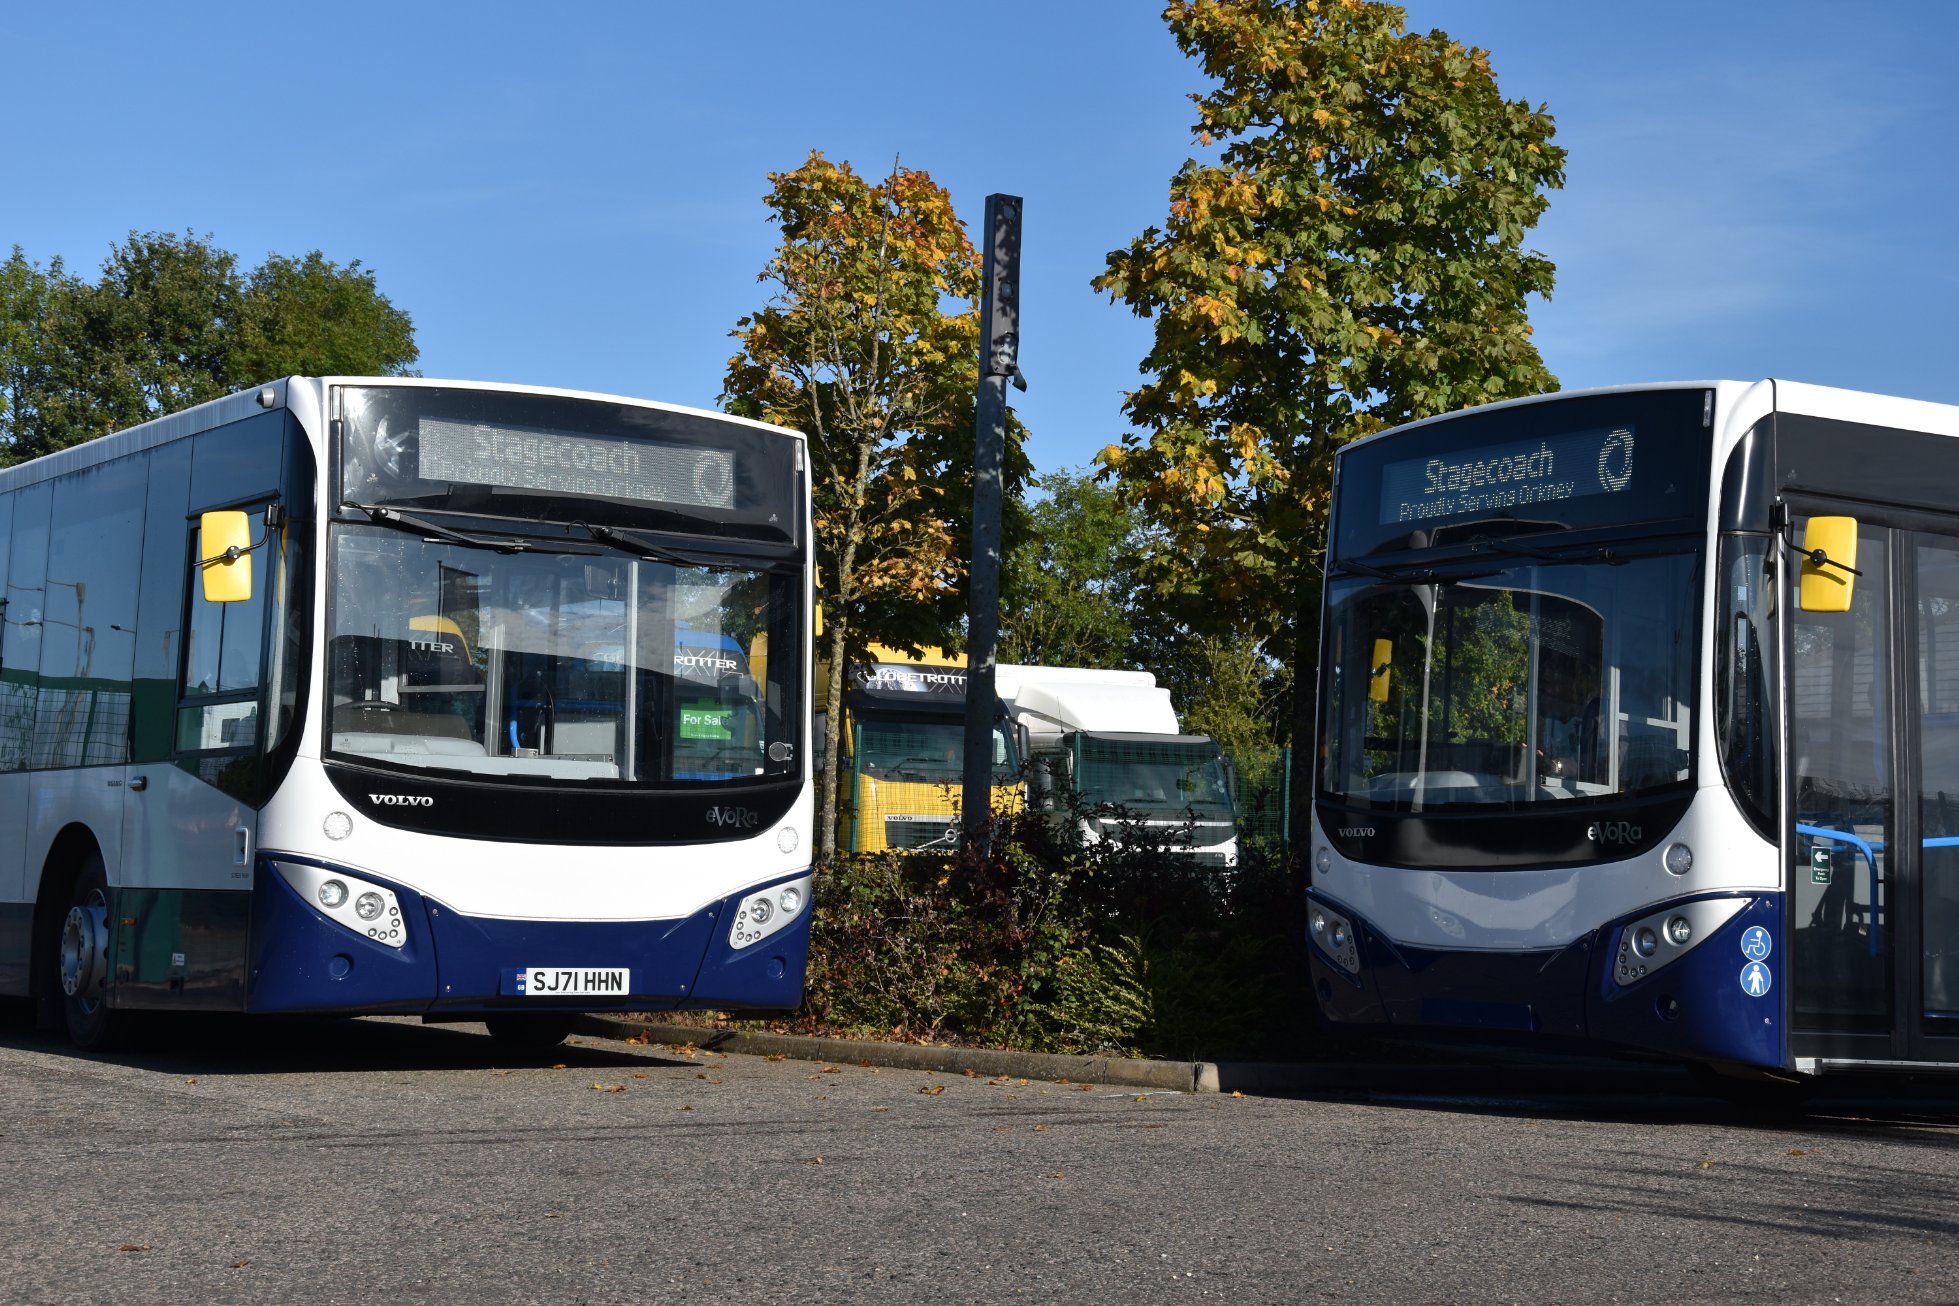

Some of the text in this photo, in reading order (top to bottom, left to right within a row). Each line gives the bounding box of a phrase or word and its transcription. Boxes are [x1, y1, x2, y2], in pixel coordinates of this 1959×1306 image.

[473, 424, 639, 475] Stagecoach
[1424, 442, 1554, 493] Stagecoach
[1399, 497, 1455, 521] Proudly
[1520, 481, 1575, 504] Orkney
[408, 640, 454, 653] TTER
[674, 655, 737, 669] ROTTER
[683, 714, 701, 725] For
[368, 794, 434, 807] VOLVO
[1338, 827, 1376, 837] VOLVO
[533, 971, 623, 992] SJ71 HHN
